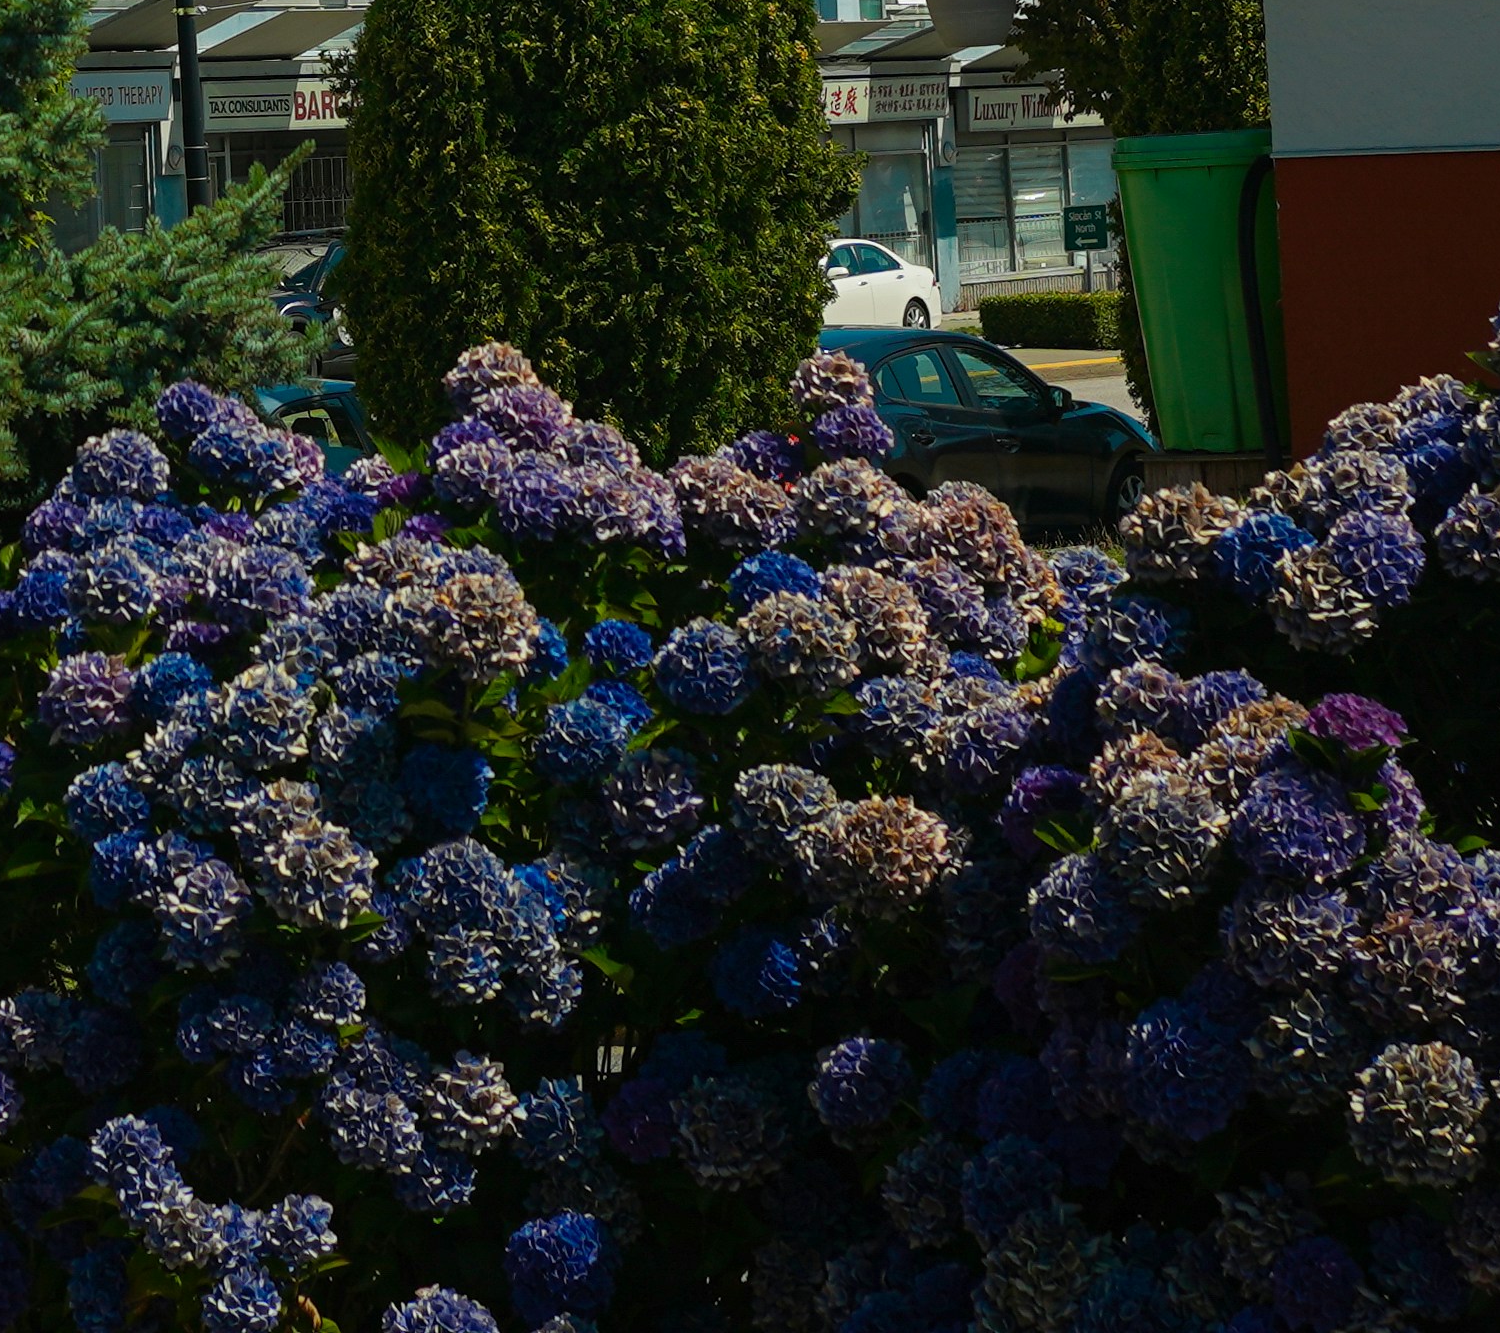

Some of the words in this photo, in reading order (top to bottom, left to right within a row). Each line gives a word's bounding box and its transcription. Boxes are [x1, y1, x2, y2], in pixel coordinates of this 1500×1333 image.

[86, 86, 114, 106] HERB
[117, 84, 164, 106] THERAPY
[209, 100, 226, 115] TAX
[228, 98, 291, 114] CONSULTANTS
[973, 96, 1018, 126] Luxury
[1075, 223, 1097, 234] North
